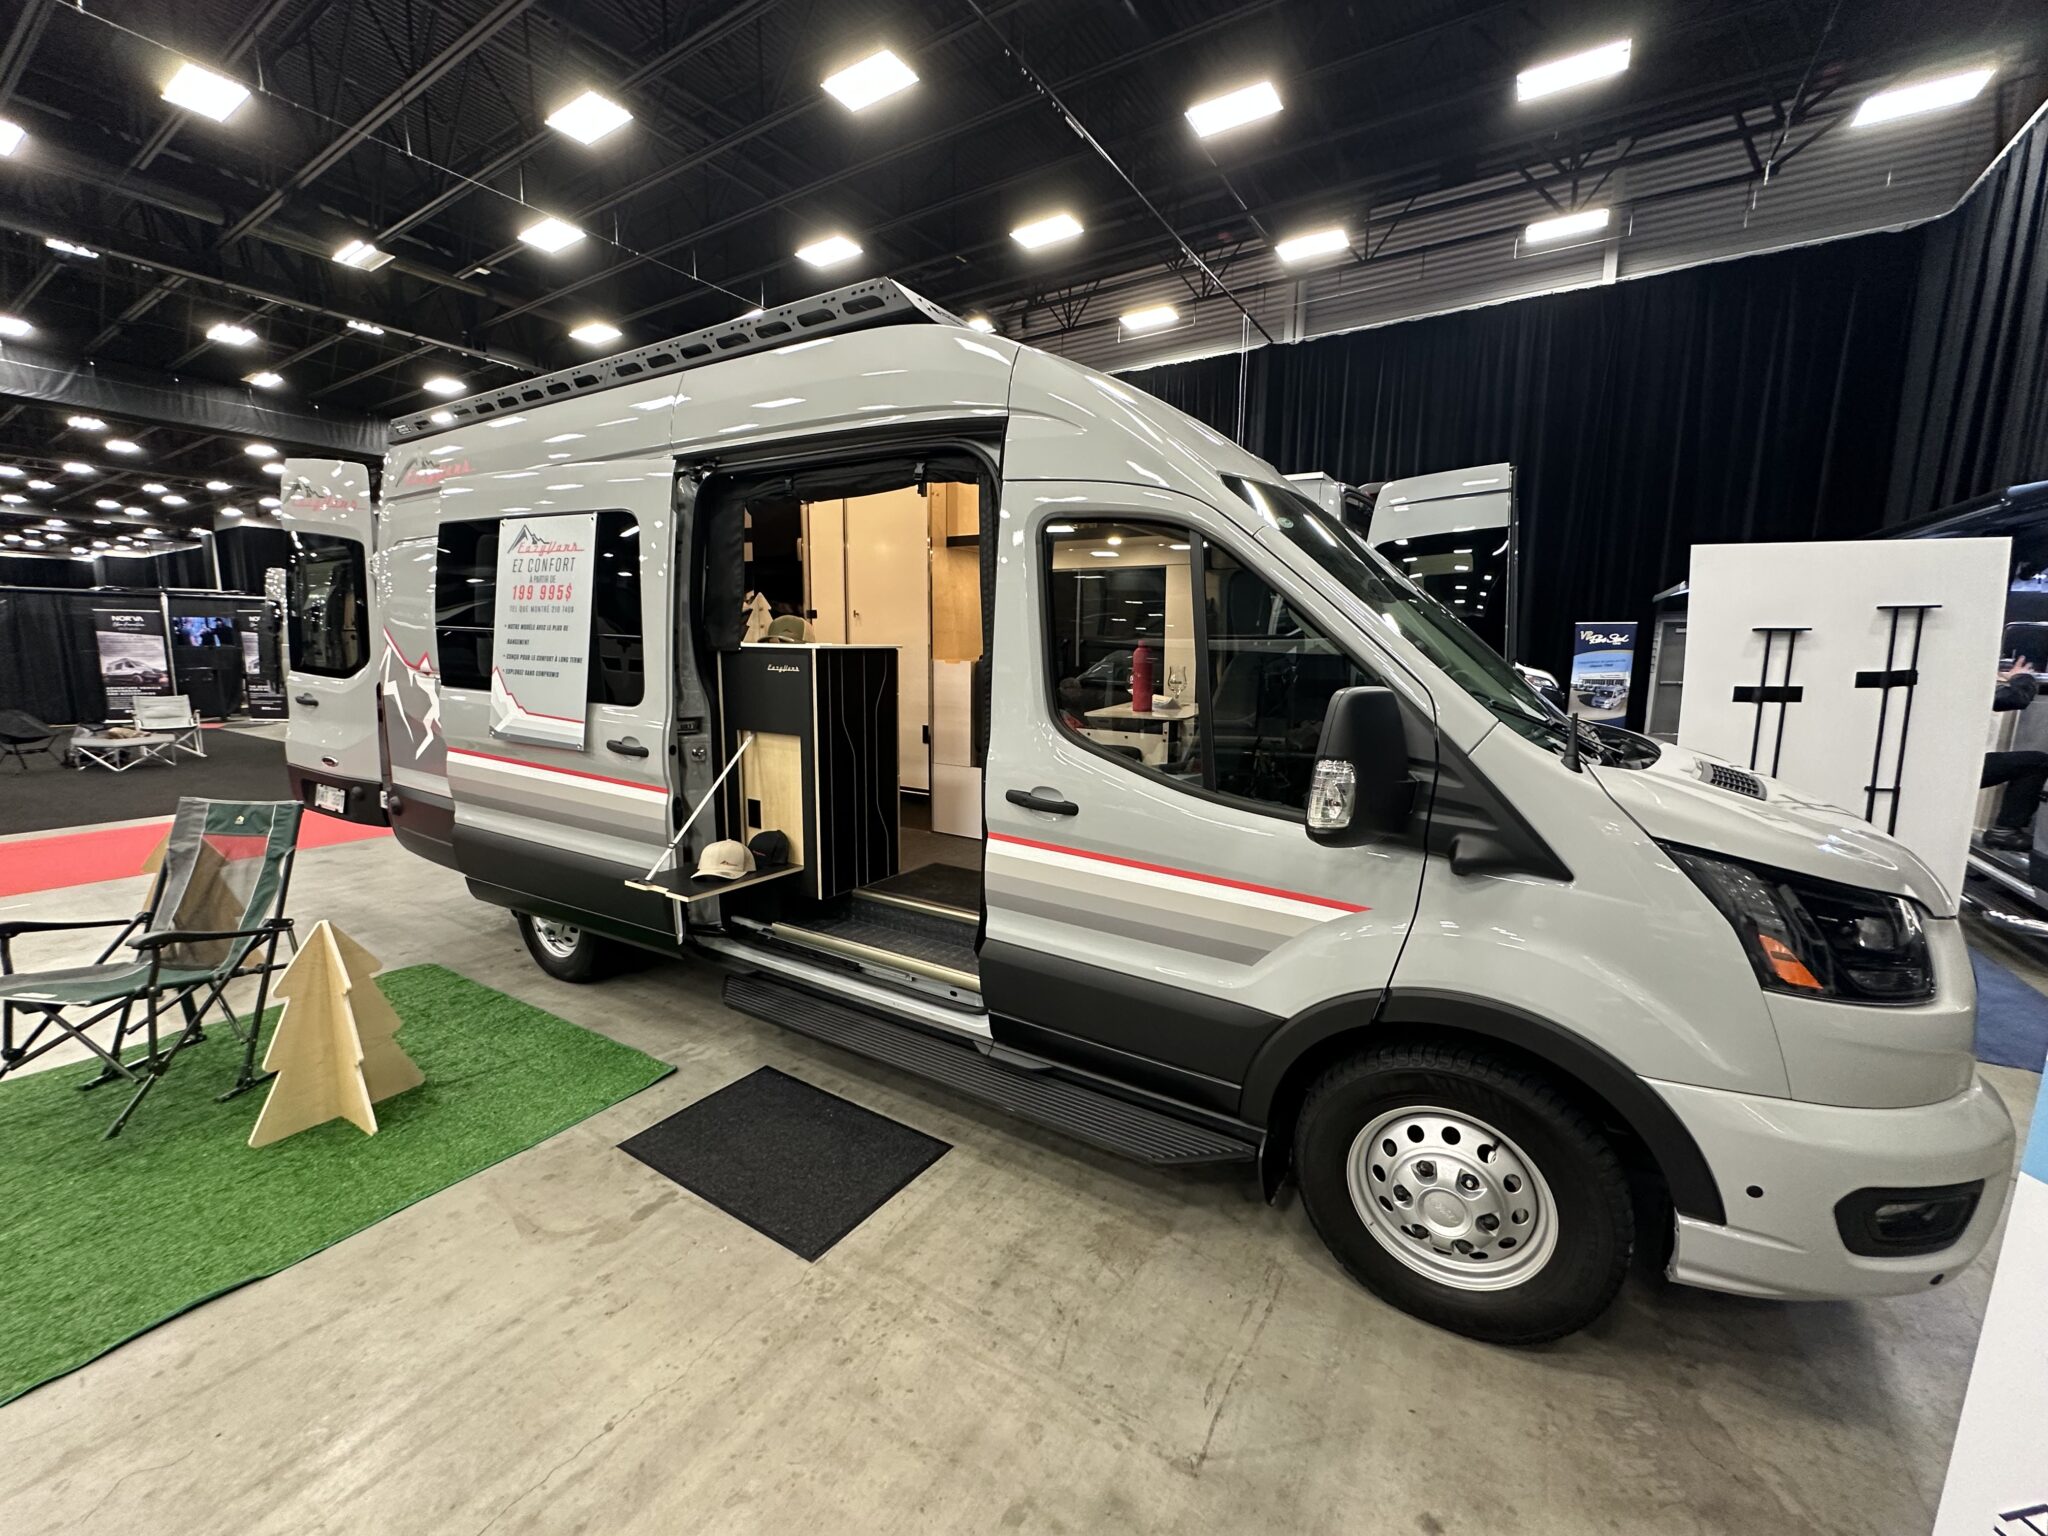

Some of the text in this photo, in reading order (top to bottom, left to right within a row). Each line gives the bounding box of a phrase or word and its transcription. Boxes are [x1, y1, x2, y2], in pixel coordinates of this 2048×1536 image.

[512, 557, 576, 573] EZ CONFORT
[512, 583, 573, 602] 199 995$
